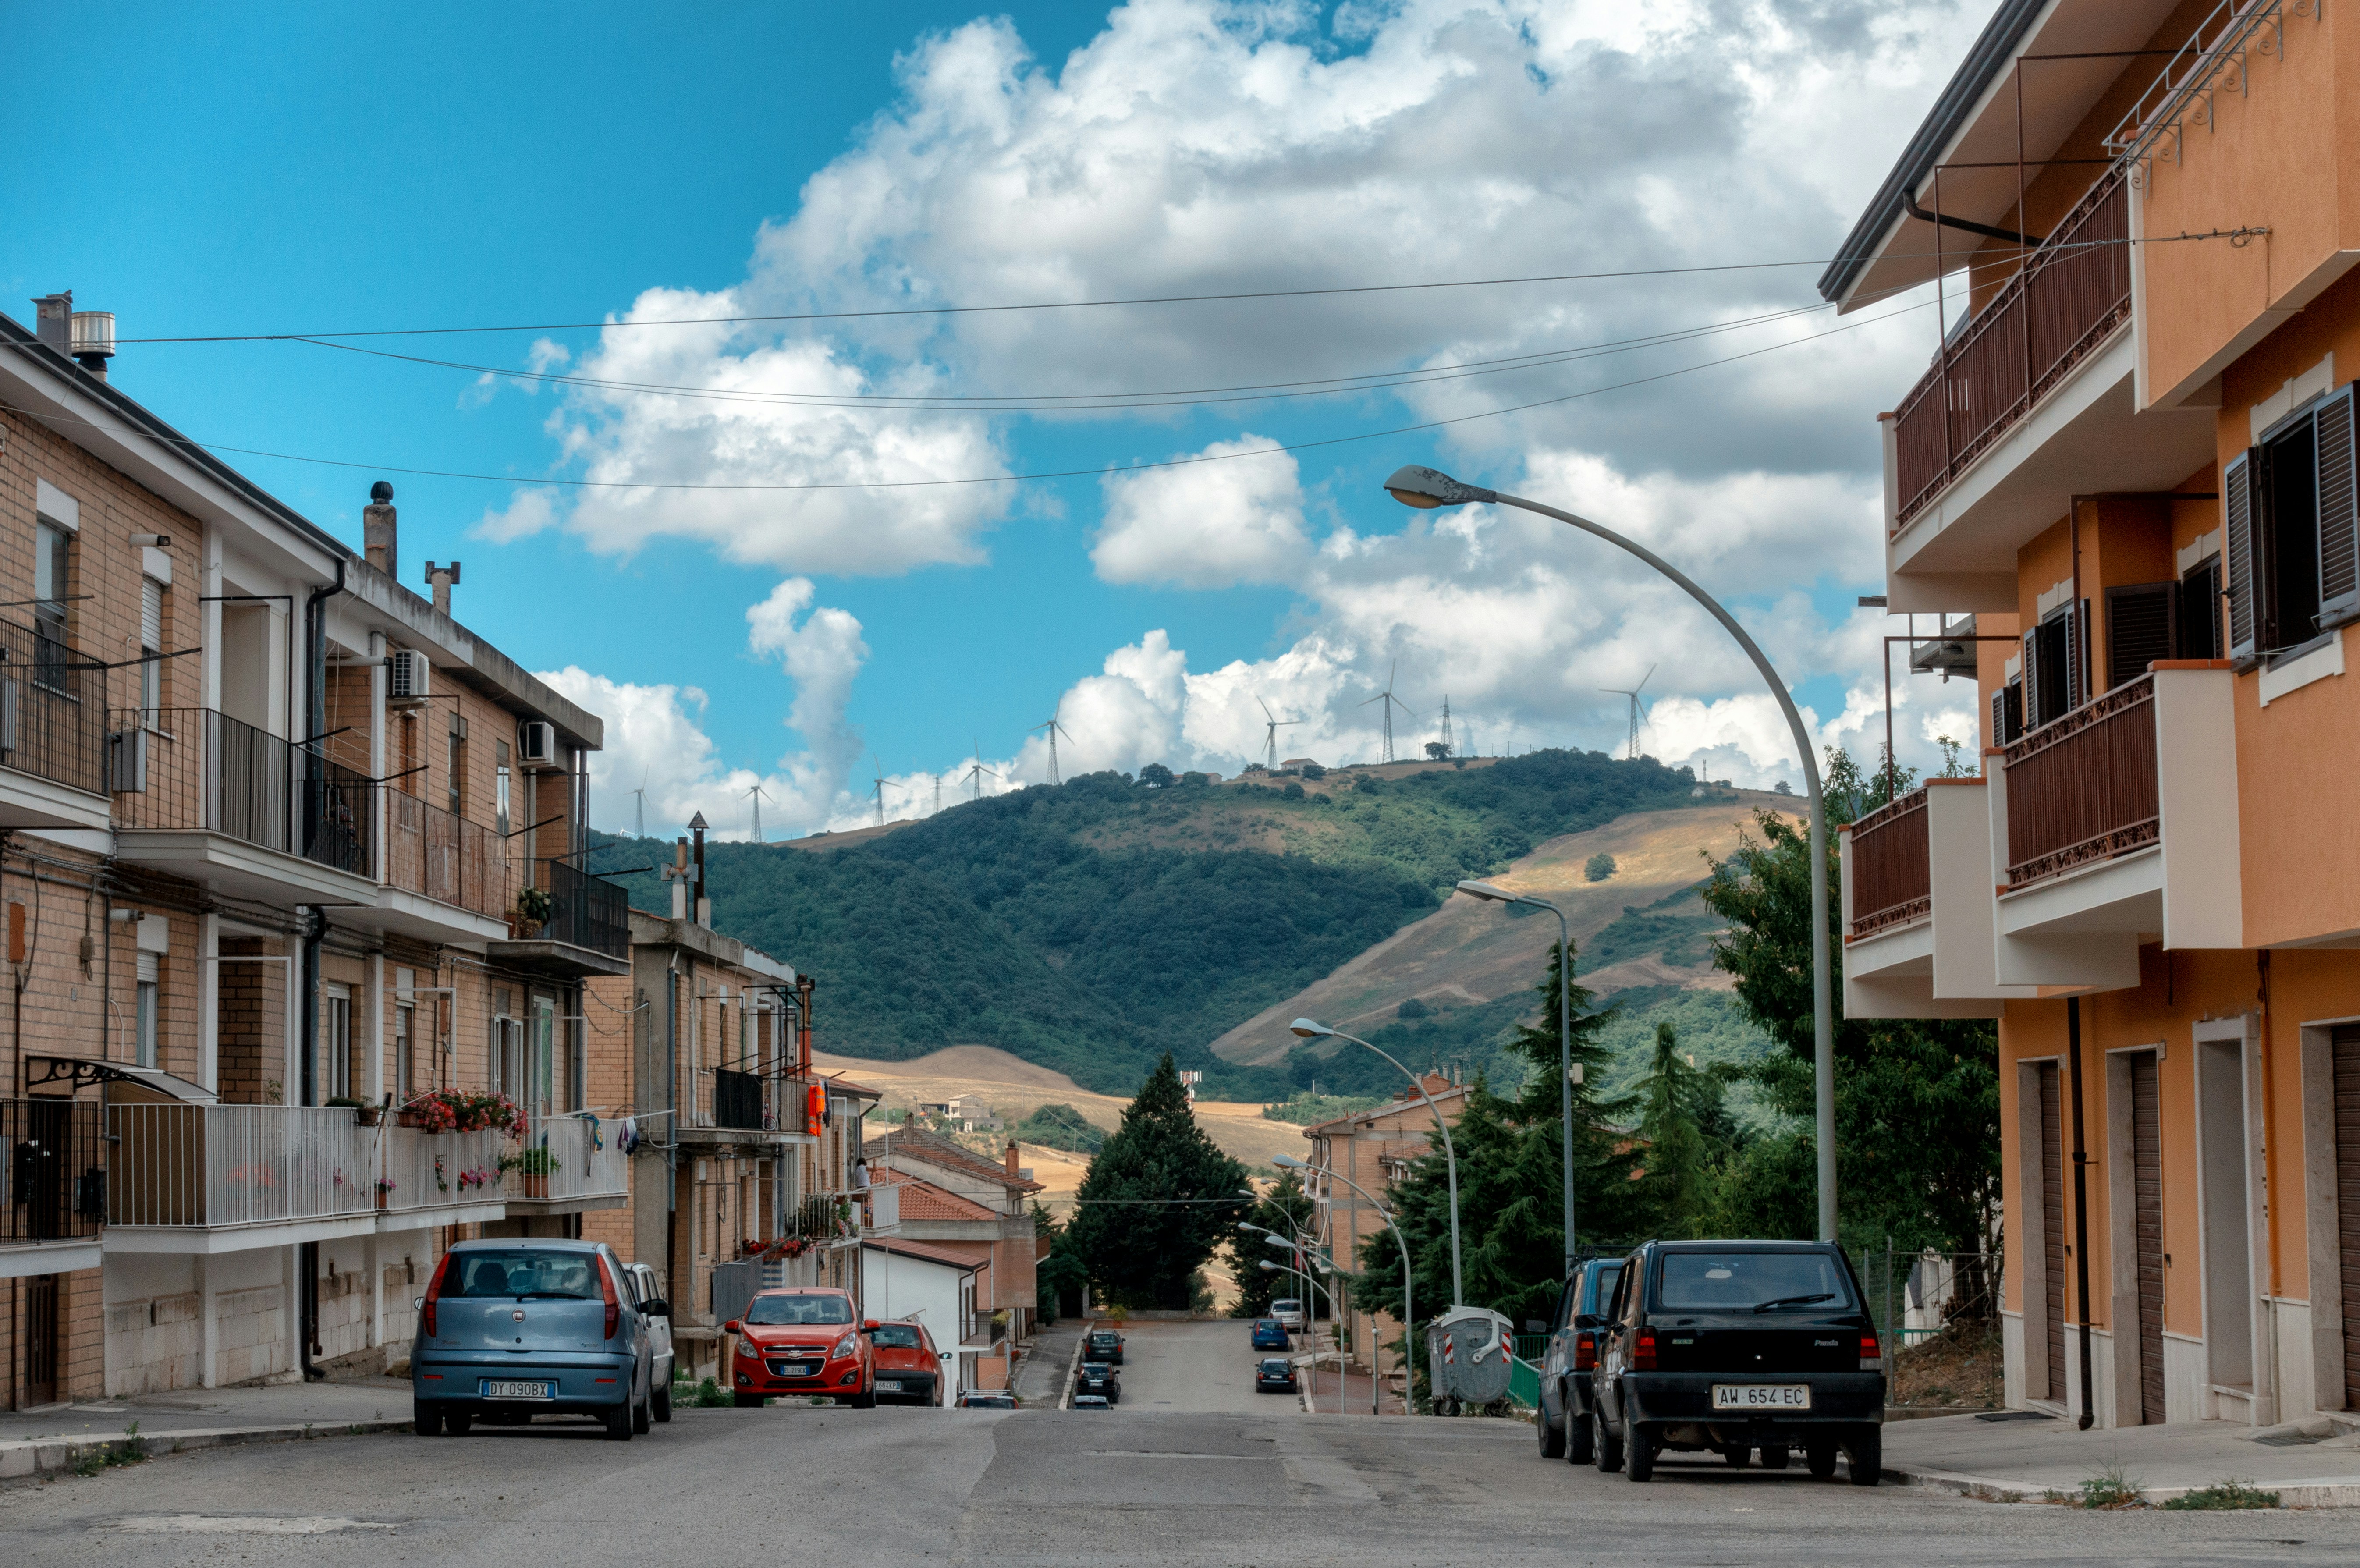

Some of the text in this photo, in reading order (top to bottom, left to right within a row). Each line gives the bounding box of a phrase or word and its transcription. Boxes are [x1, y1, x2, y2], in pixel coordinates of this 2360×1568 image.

[491, 1383, 546, 1396] DY 090BX
[1721, 1389, 1803, 1403] AW 654 EC
